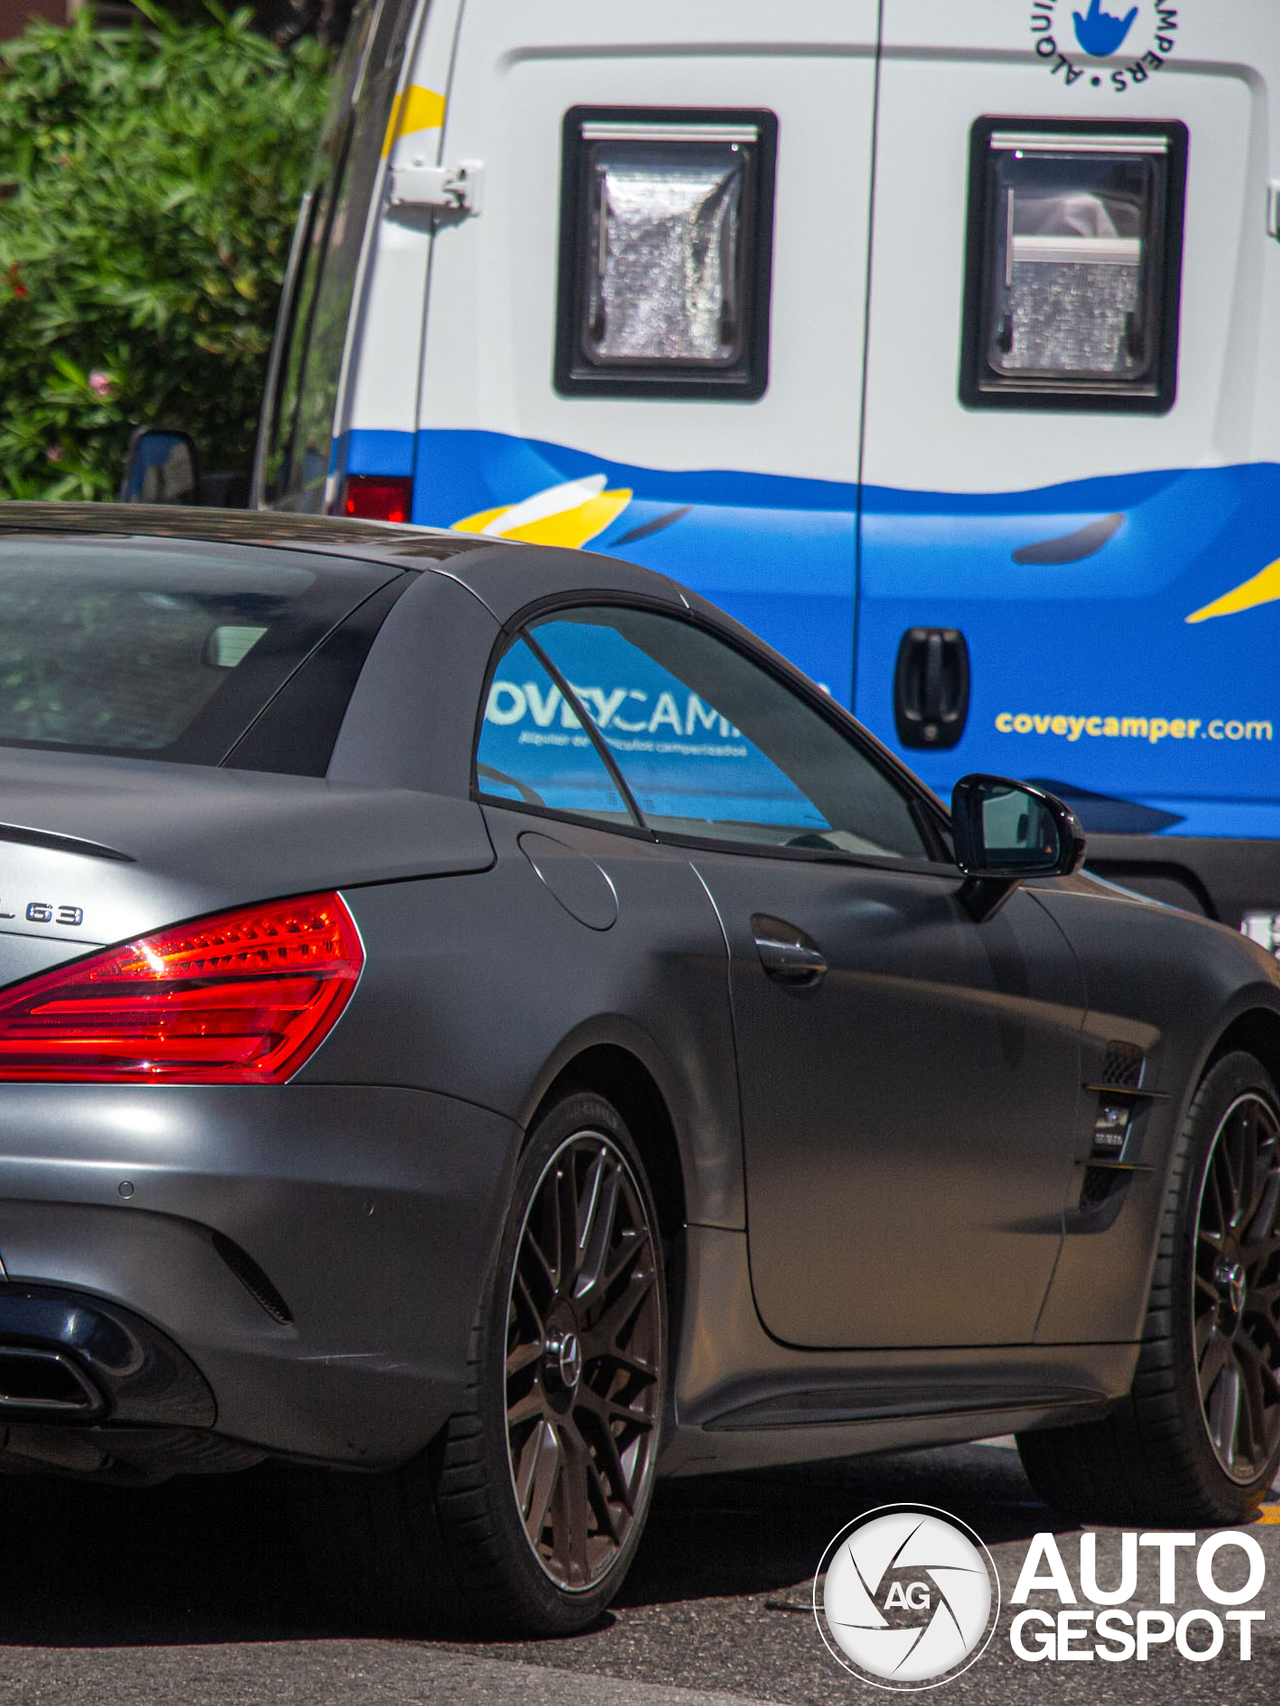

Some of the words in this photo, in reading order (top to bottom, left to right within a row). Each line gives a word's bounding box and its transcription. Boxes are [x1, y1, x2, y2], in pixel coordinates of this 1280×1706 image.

[1030, 0, 1085, 86] ALQUI
[994, 712, 1273, 744] coveycamper.com
[25, 901, 84, 926] 63
